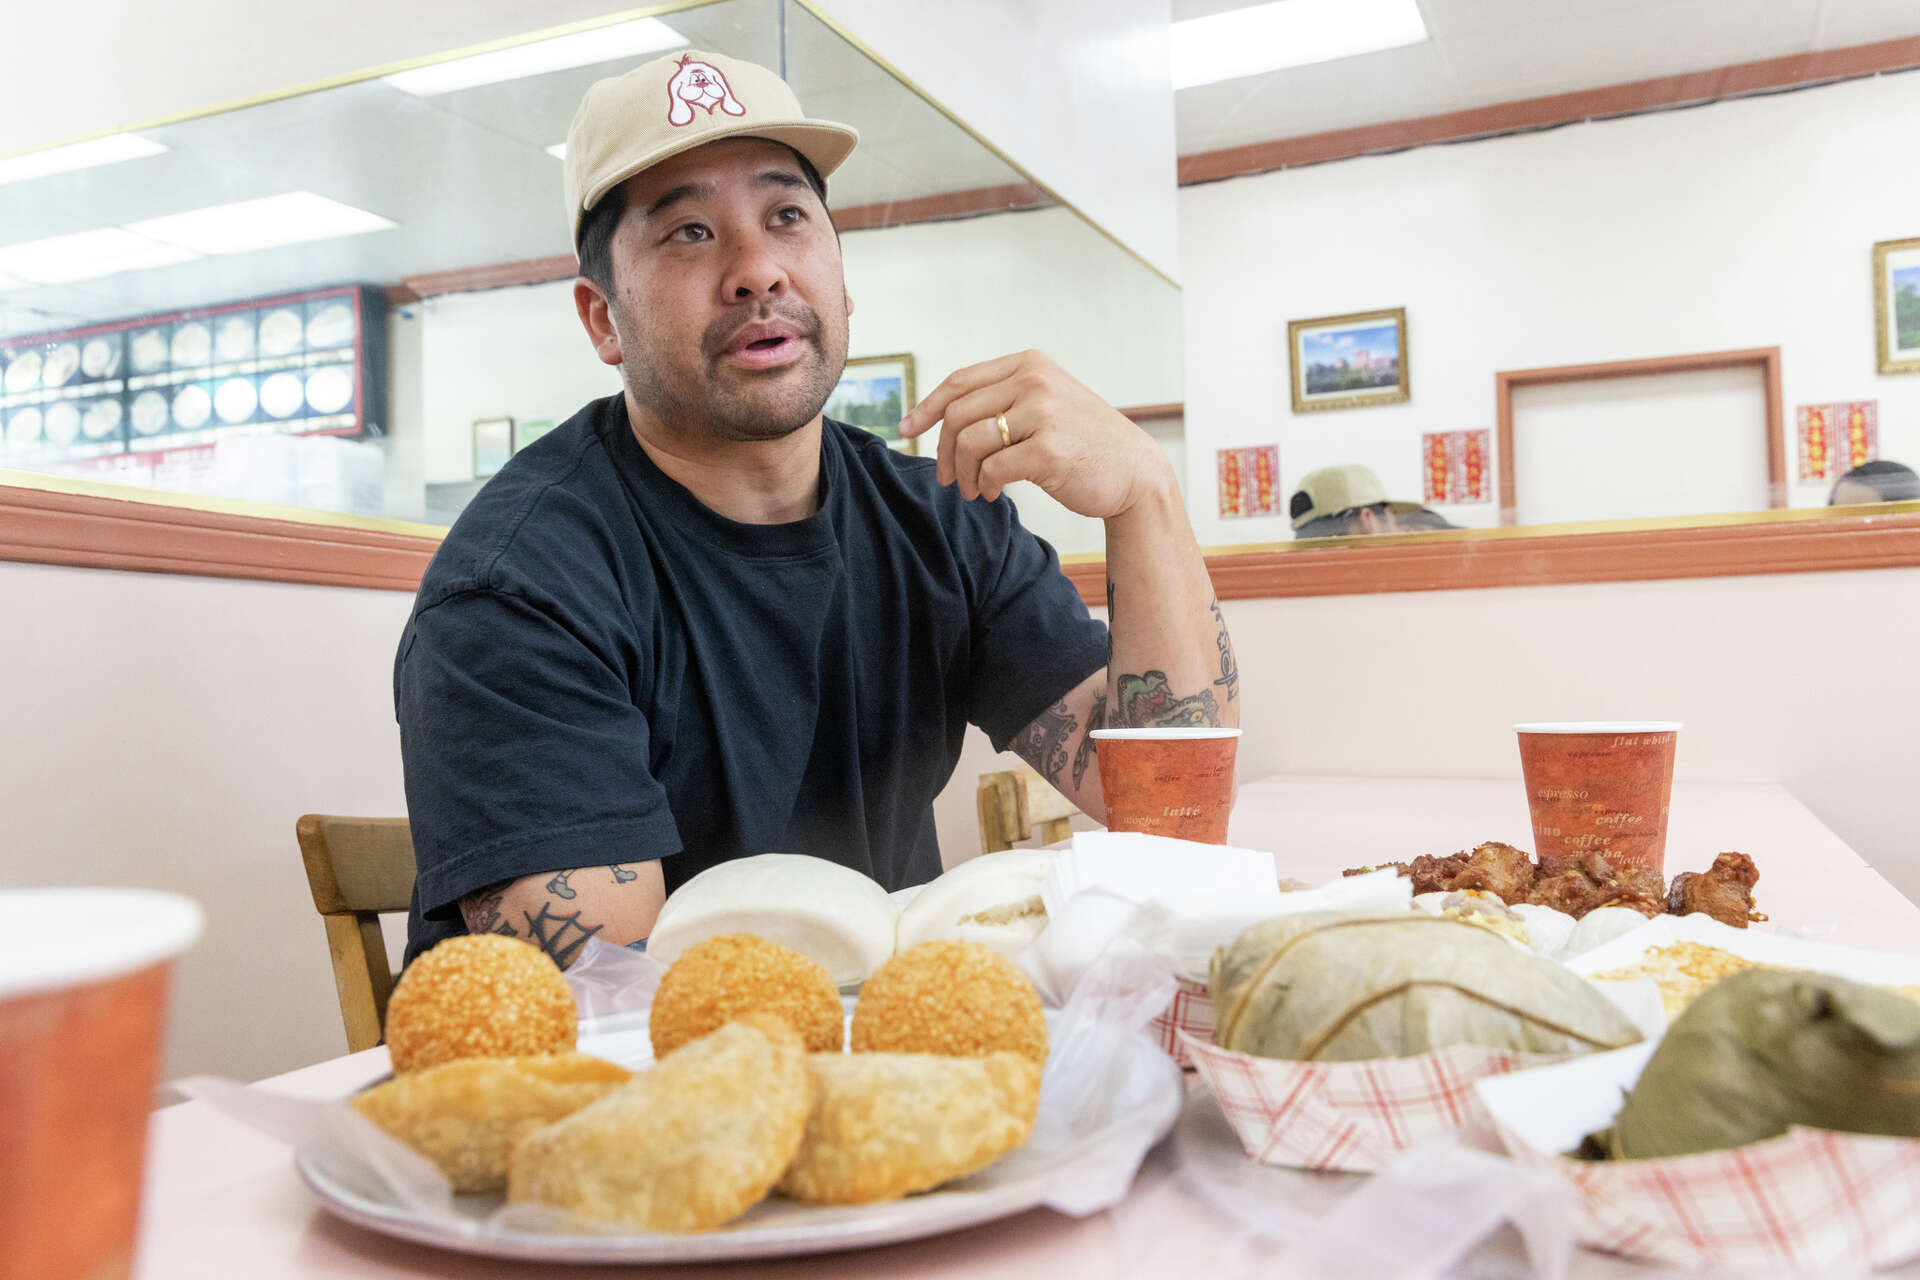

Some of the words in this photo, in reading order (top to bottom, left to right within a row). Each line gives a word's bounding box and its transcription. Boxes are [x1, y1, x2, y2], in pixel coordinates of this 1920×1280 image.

[1611, 735, 1638, 748] flat
[1595, 813, 1643, 829] coffee
[1564, 834, 1612, 848] coffee
[1571, 846, 1622, 860] moha
